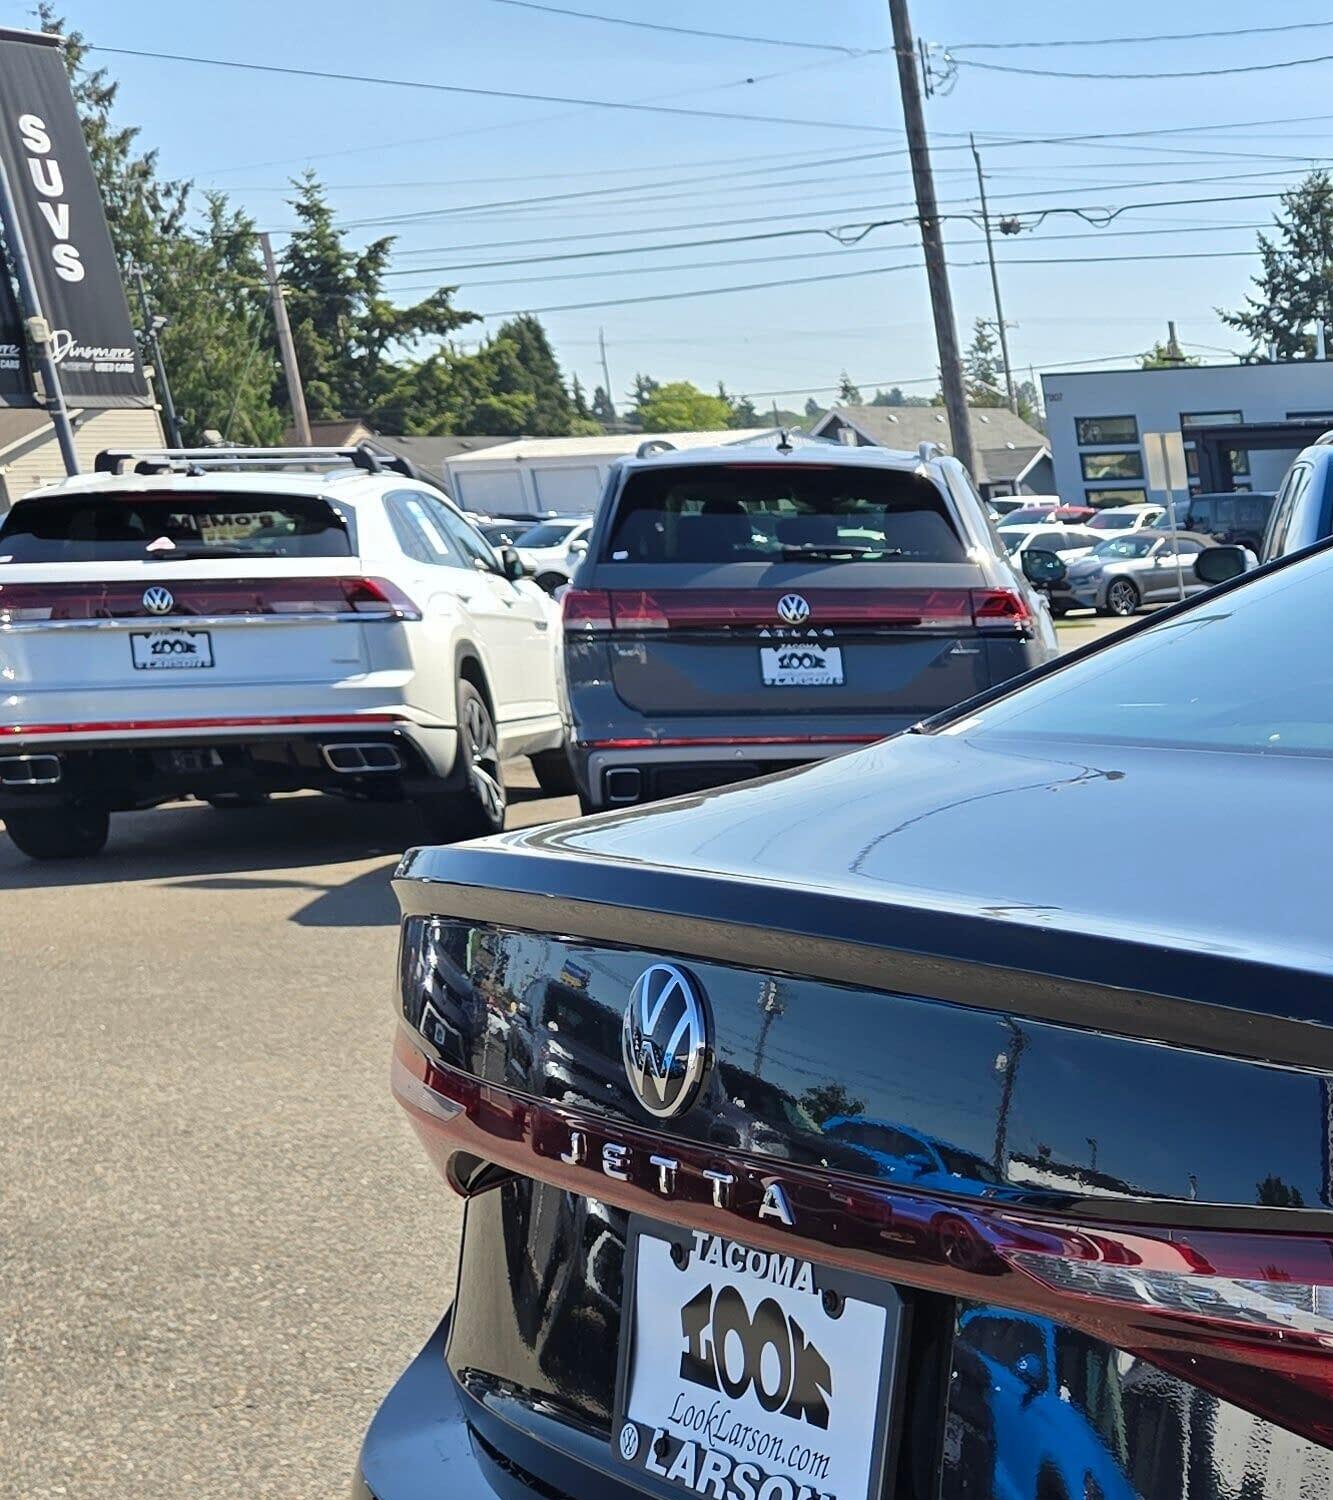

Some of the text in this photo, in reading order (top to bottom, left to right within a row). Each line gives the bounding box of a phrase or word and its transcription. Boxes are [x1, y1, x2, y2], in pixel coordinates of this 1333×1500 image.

[18, 113, 86, 282] SUVS
[49, 329, 135, 363] Dinsmore
[561, 1132, 796, 1226] JETTA
[692, 1229, 817, 1295] TACOMA
[680, 1283, 833, 1431] LOOK
[667, 1393, 832, 1480] LookLarson.com
